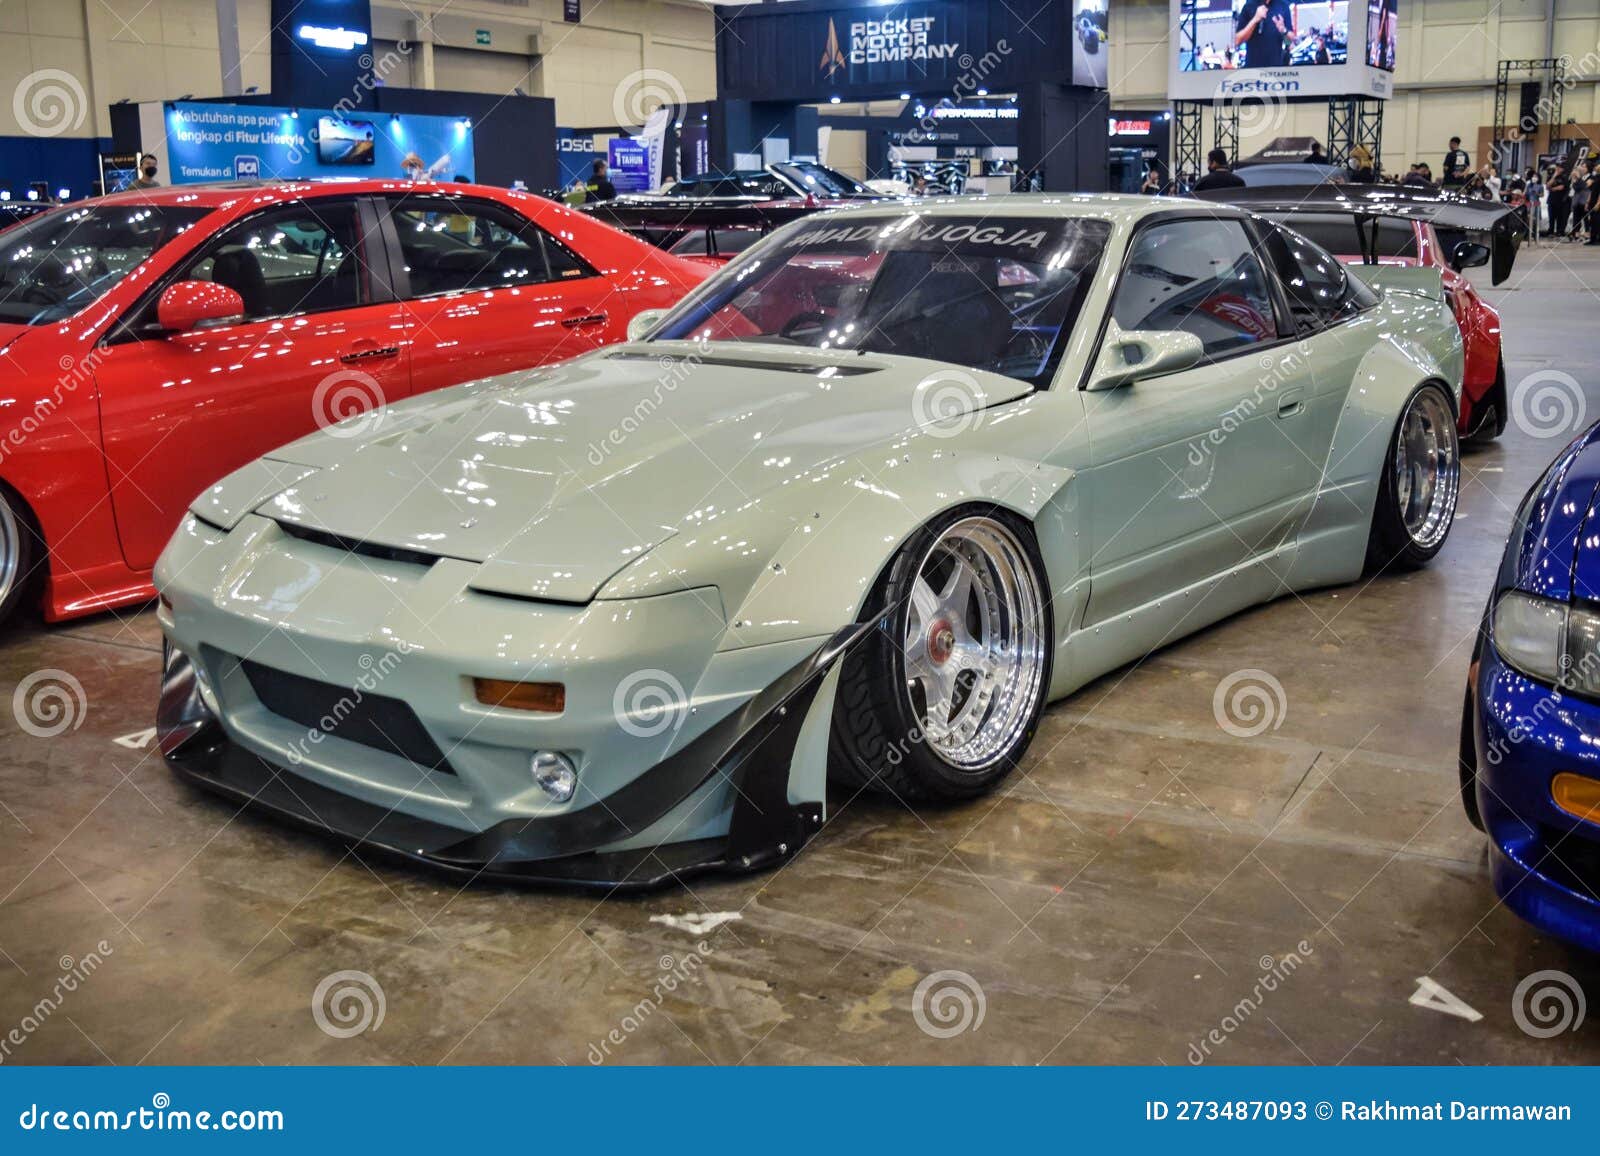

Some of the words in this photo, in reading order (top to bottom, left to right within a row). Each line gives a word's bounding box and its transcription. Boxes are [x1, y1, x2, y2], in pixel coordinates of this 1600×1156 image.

[851, 17, 935, 36] ROCKET
[853, 32, 927, 50] MOTOR
[851, 44, 959, 64] COMPANY
[1221, 79, 1300, 93] Fastron
[175, 110, 236, 125] Kebutuhan
[237, 116, 257, 127] apa
[258, 117, 281, 127] pun,
[177, 129, 222, 144] lengkap
[224, 132, 234, 143] di
[236, 133, 259, 144] Fitur
[261, 134, 304, 147] Lifestyle
[181, 166, 221, 177] Temukan
[223, 166, 232, 176] di
[238, 162, 258, 173] BCA
[784, 225, 1048, 249] #MADNJOGJA
